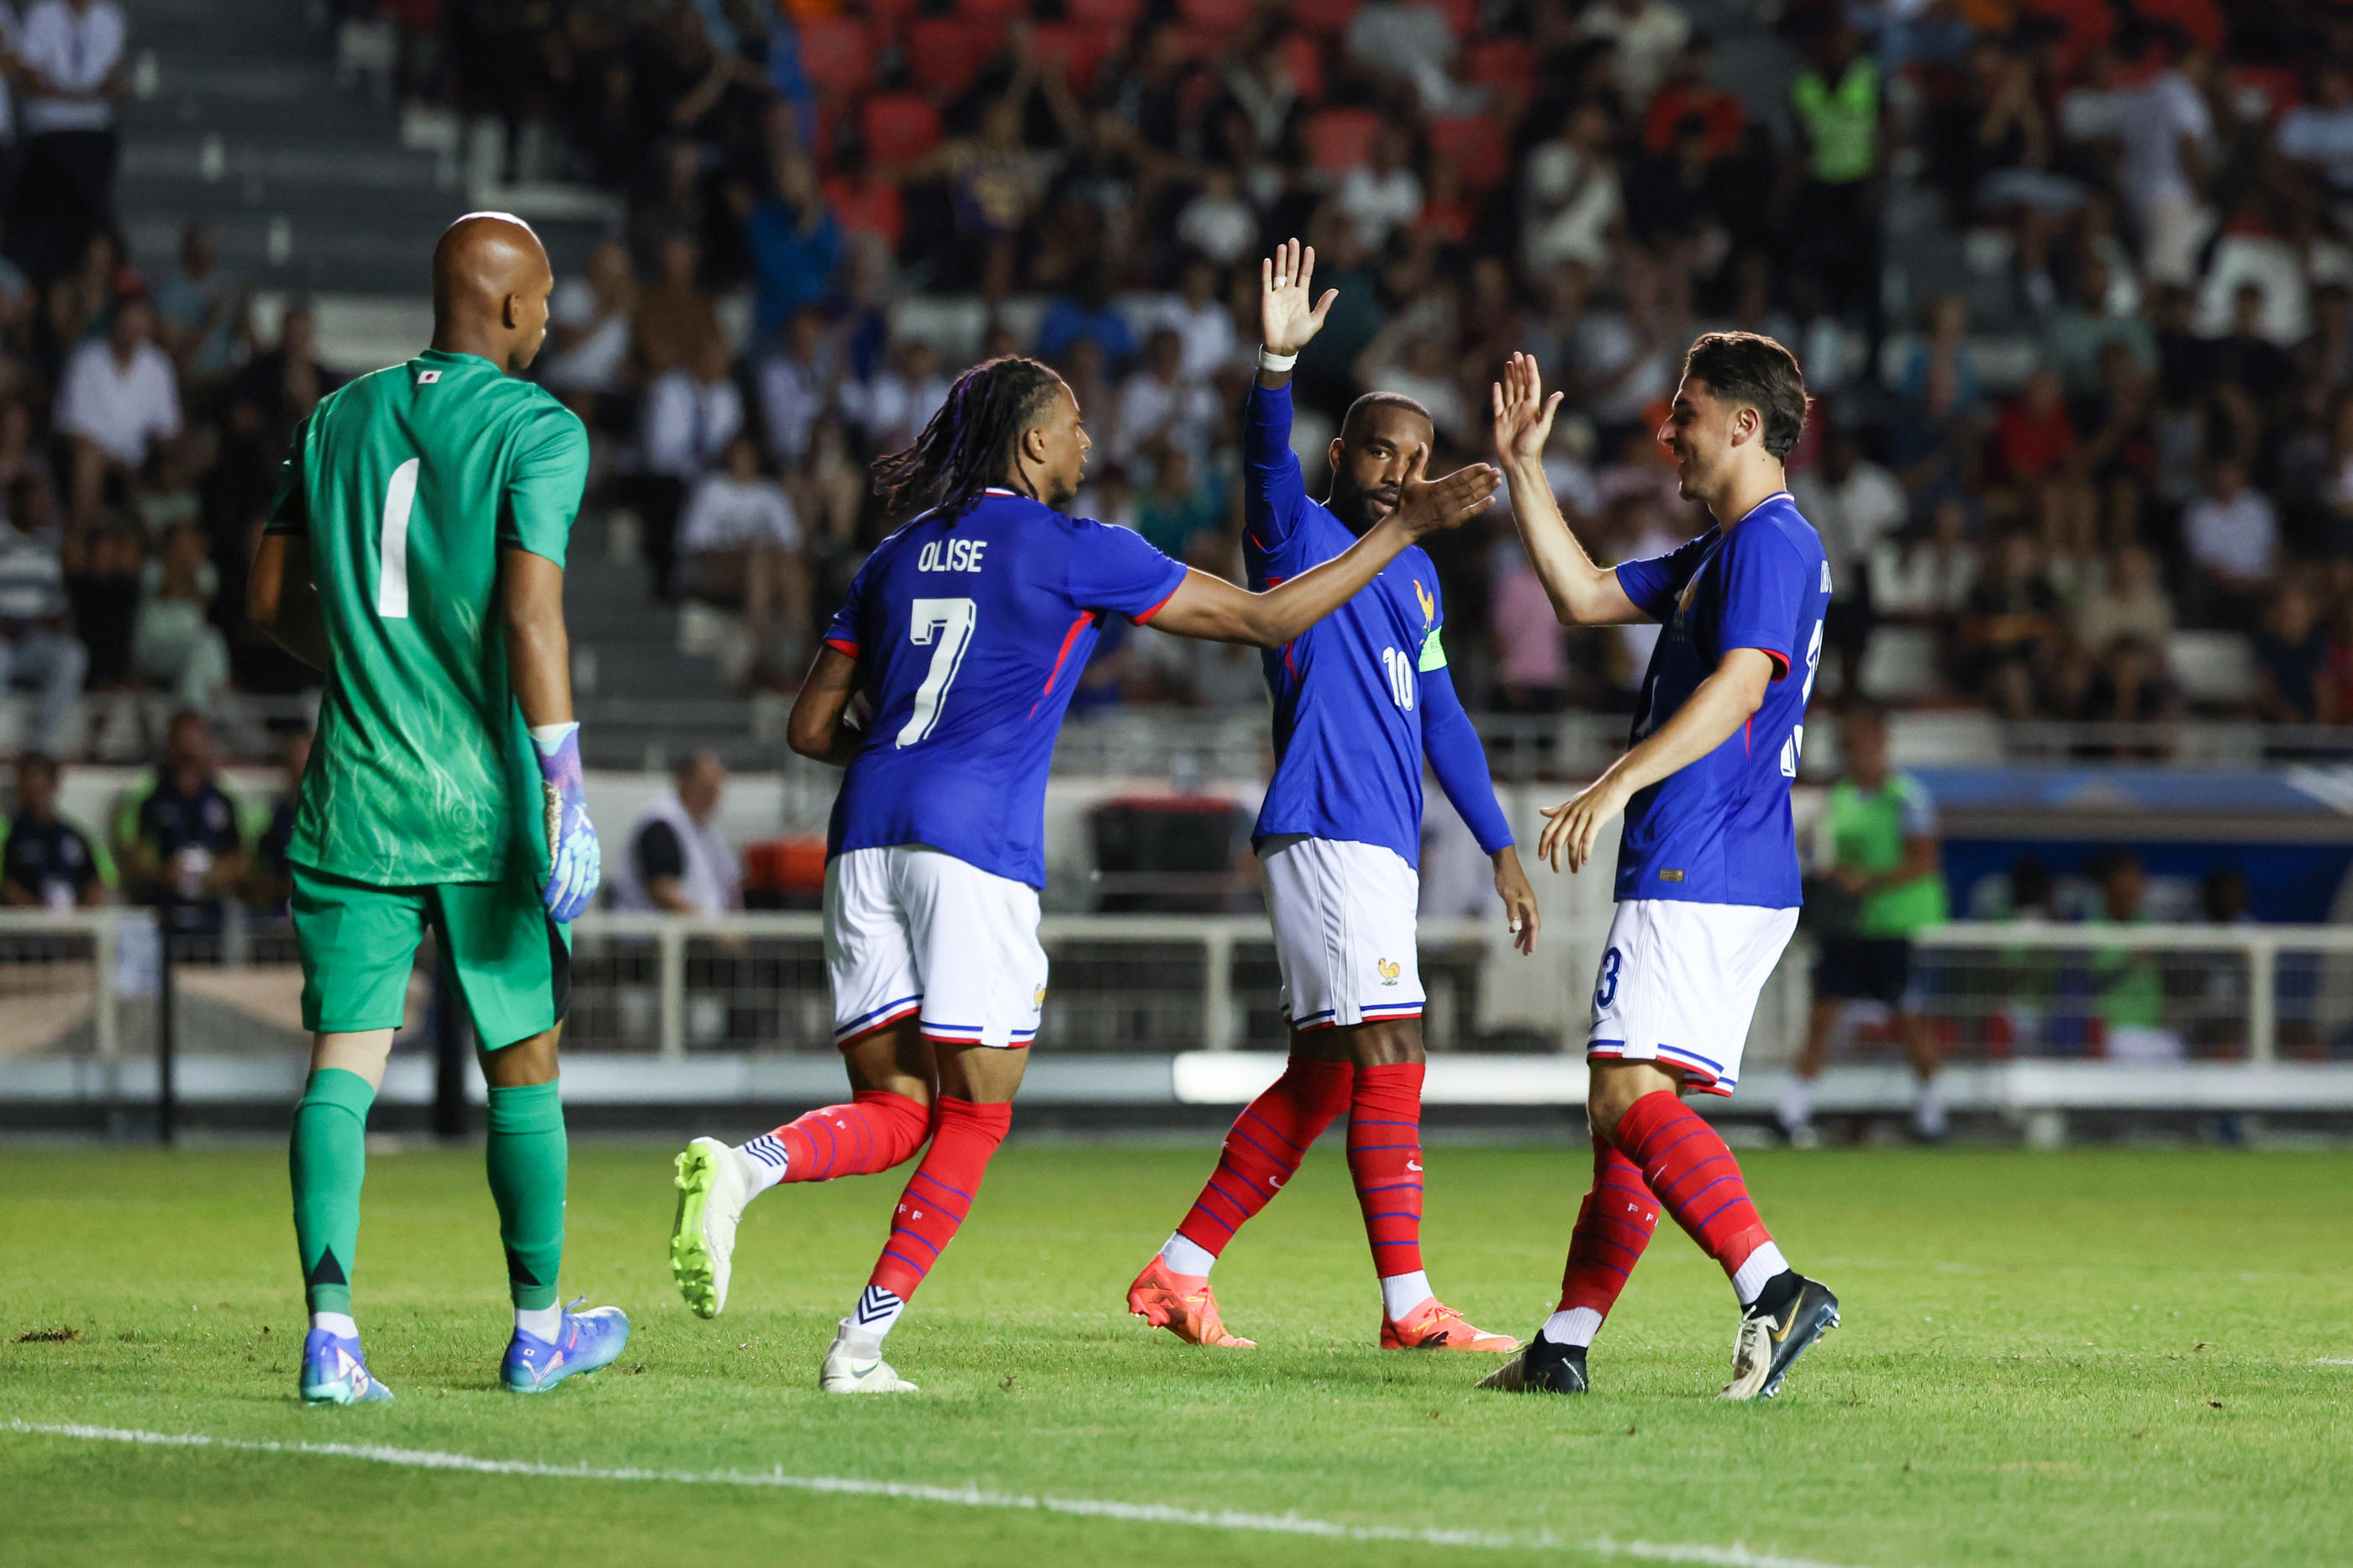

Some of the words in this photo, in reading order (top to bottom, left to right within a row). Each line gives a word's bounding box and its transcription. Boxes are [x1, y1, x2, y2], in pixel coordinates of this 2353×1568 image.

[379, 458, 419, 618] 1
[918, 539, 987, 573] OLISE
[896, 597, 976, 750] 7
[1382, 646, 1413, 711] 10
[1596, 946, 1622, 1009] 3
